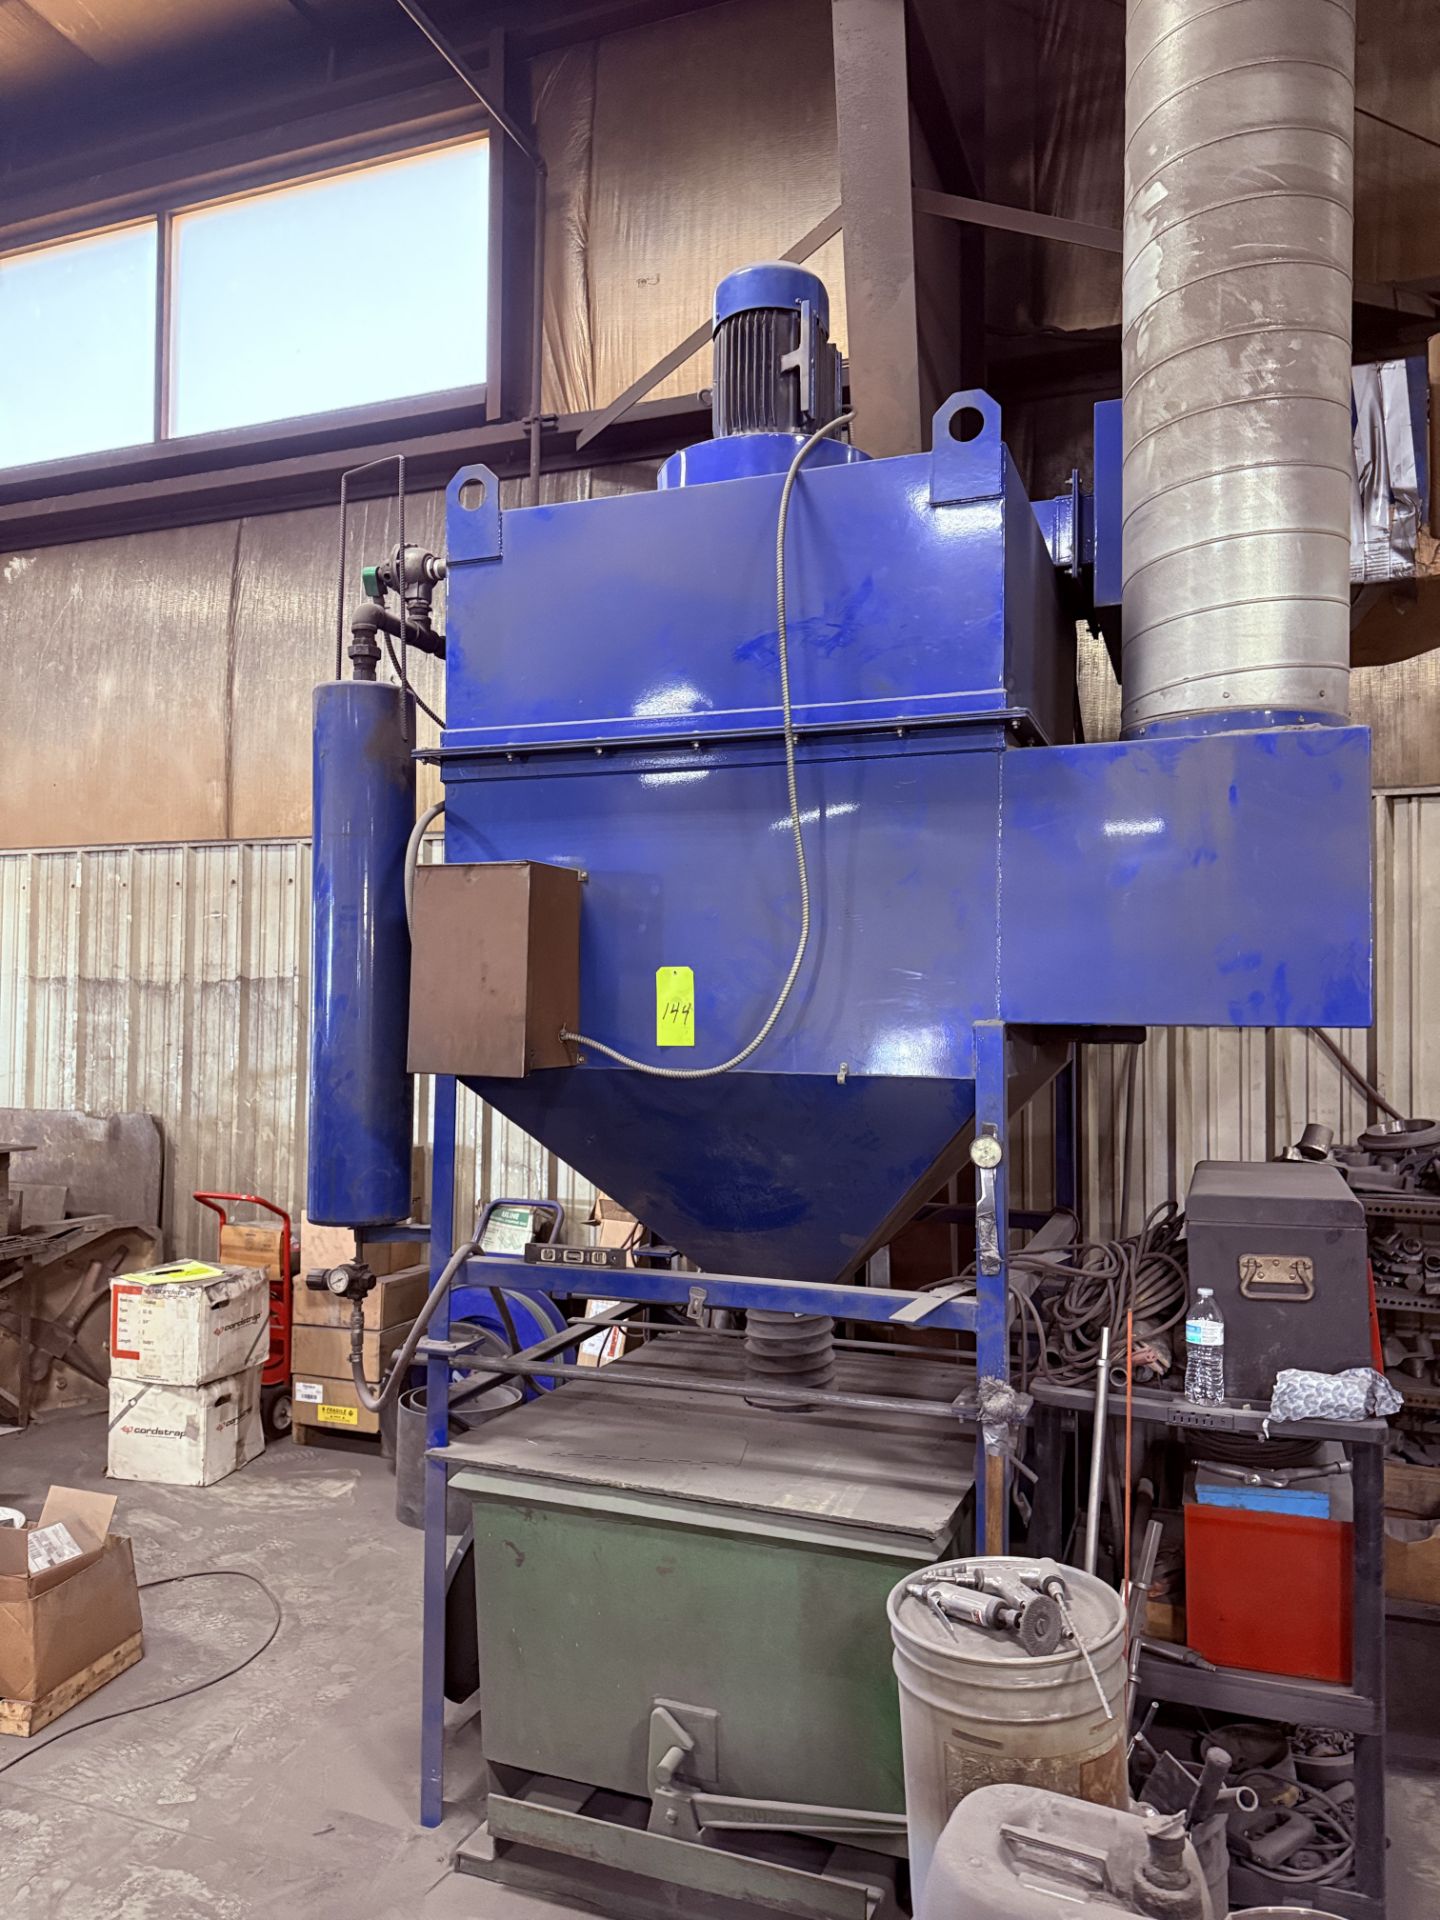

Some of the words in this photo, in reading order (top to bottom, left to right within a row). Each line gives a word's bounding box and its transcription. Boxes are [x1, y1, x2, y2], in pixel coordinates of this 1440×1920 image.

[662, 1001, 692, 1025] 144
[154, 1288, 195, 1298] cordstap
[224, 1312, 261, 1331] cordstrap
[134, 1427, 186, 1439] cordstrap
